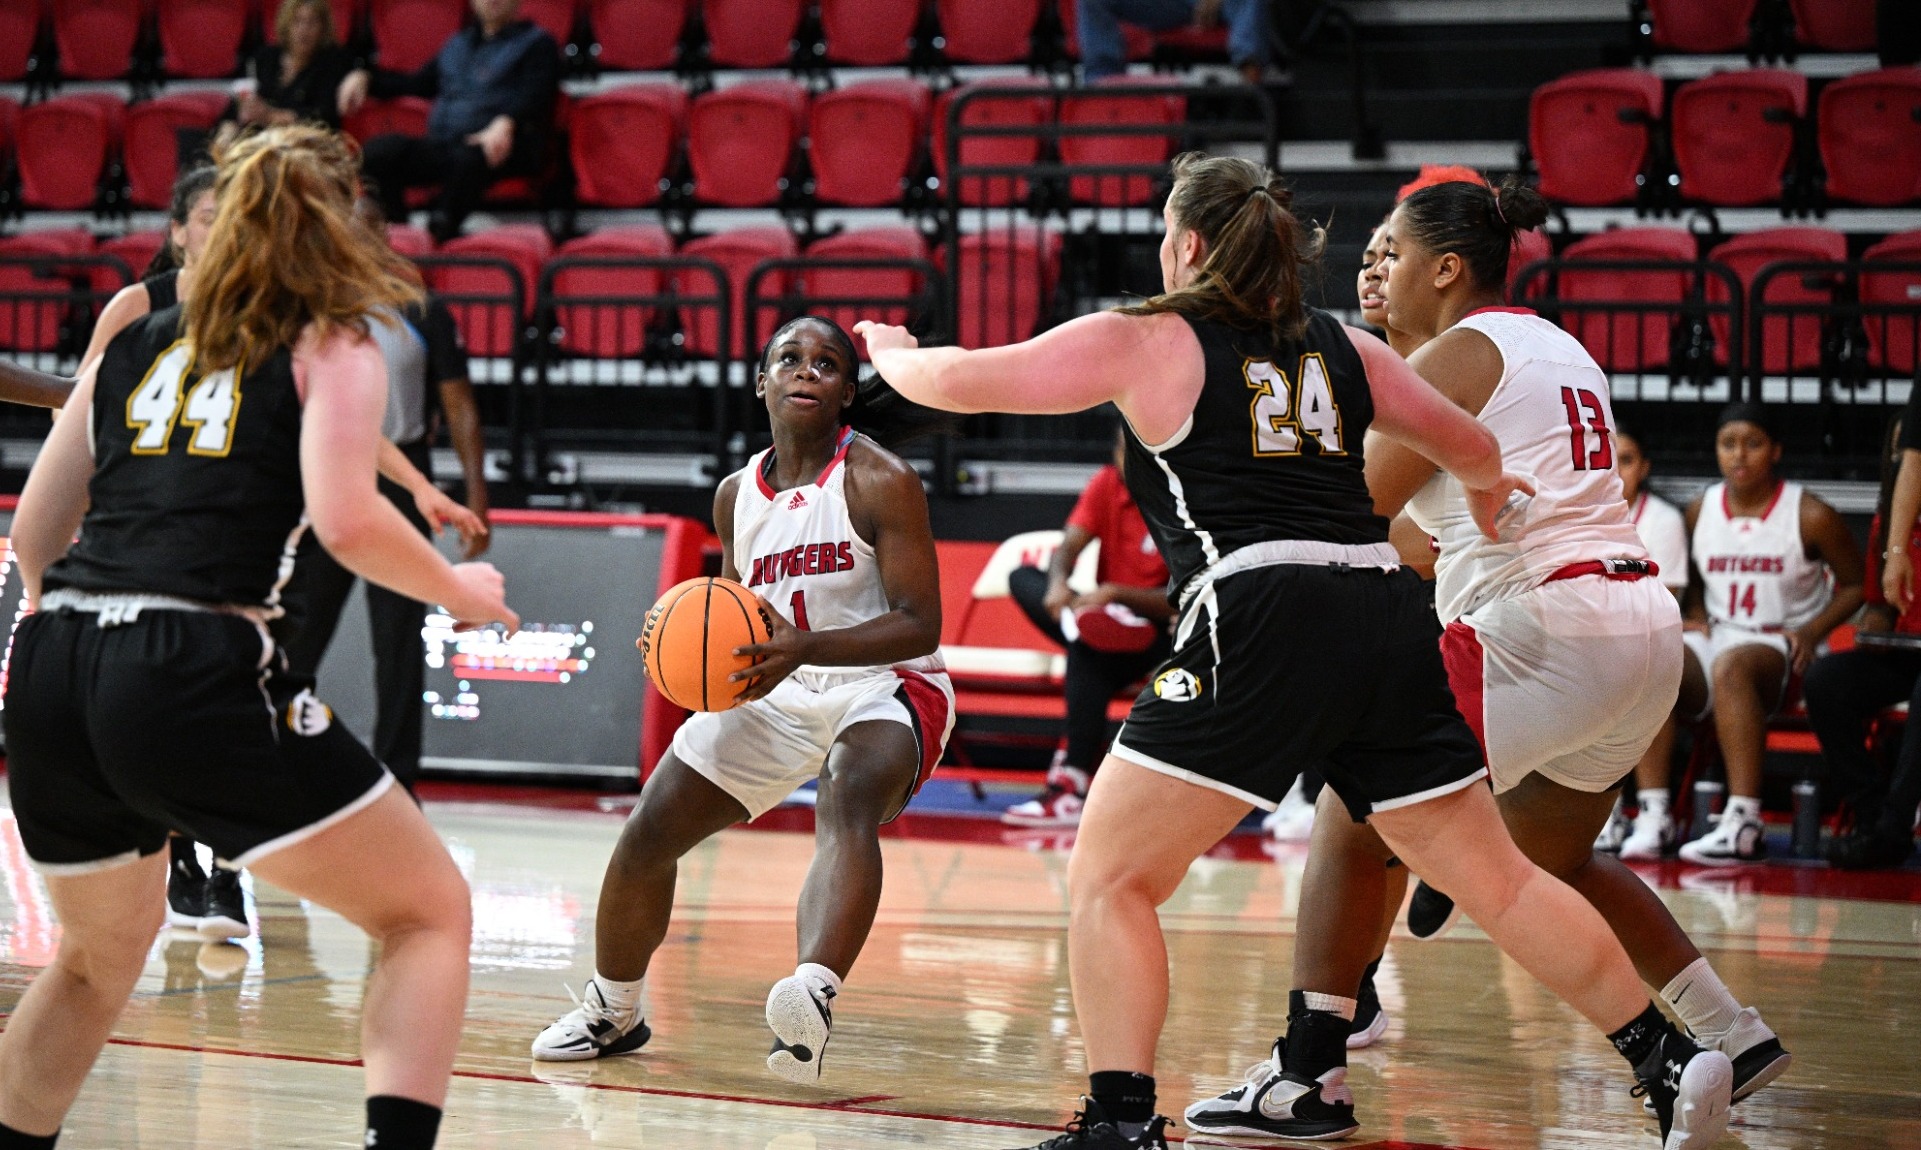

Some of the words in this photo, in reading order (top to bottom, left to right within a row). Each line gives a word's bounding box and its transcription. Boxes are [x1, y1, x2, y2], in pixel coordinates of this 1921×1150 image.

[126, 338, 246, 457] 44
[1242, 352, 1348, 457] 24
[1561, 386, 1613, 471] 13
[749, 541, 854, 587] RUTGERS
[1706, 555, 1785, 574] RUTGERS
[790, 590, 811, 631] 1
[1728, 582, 1756, 617] 14
